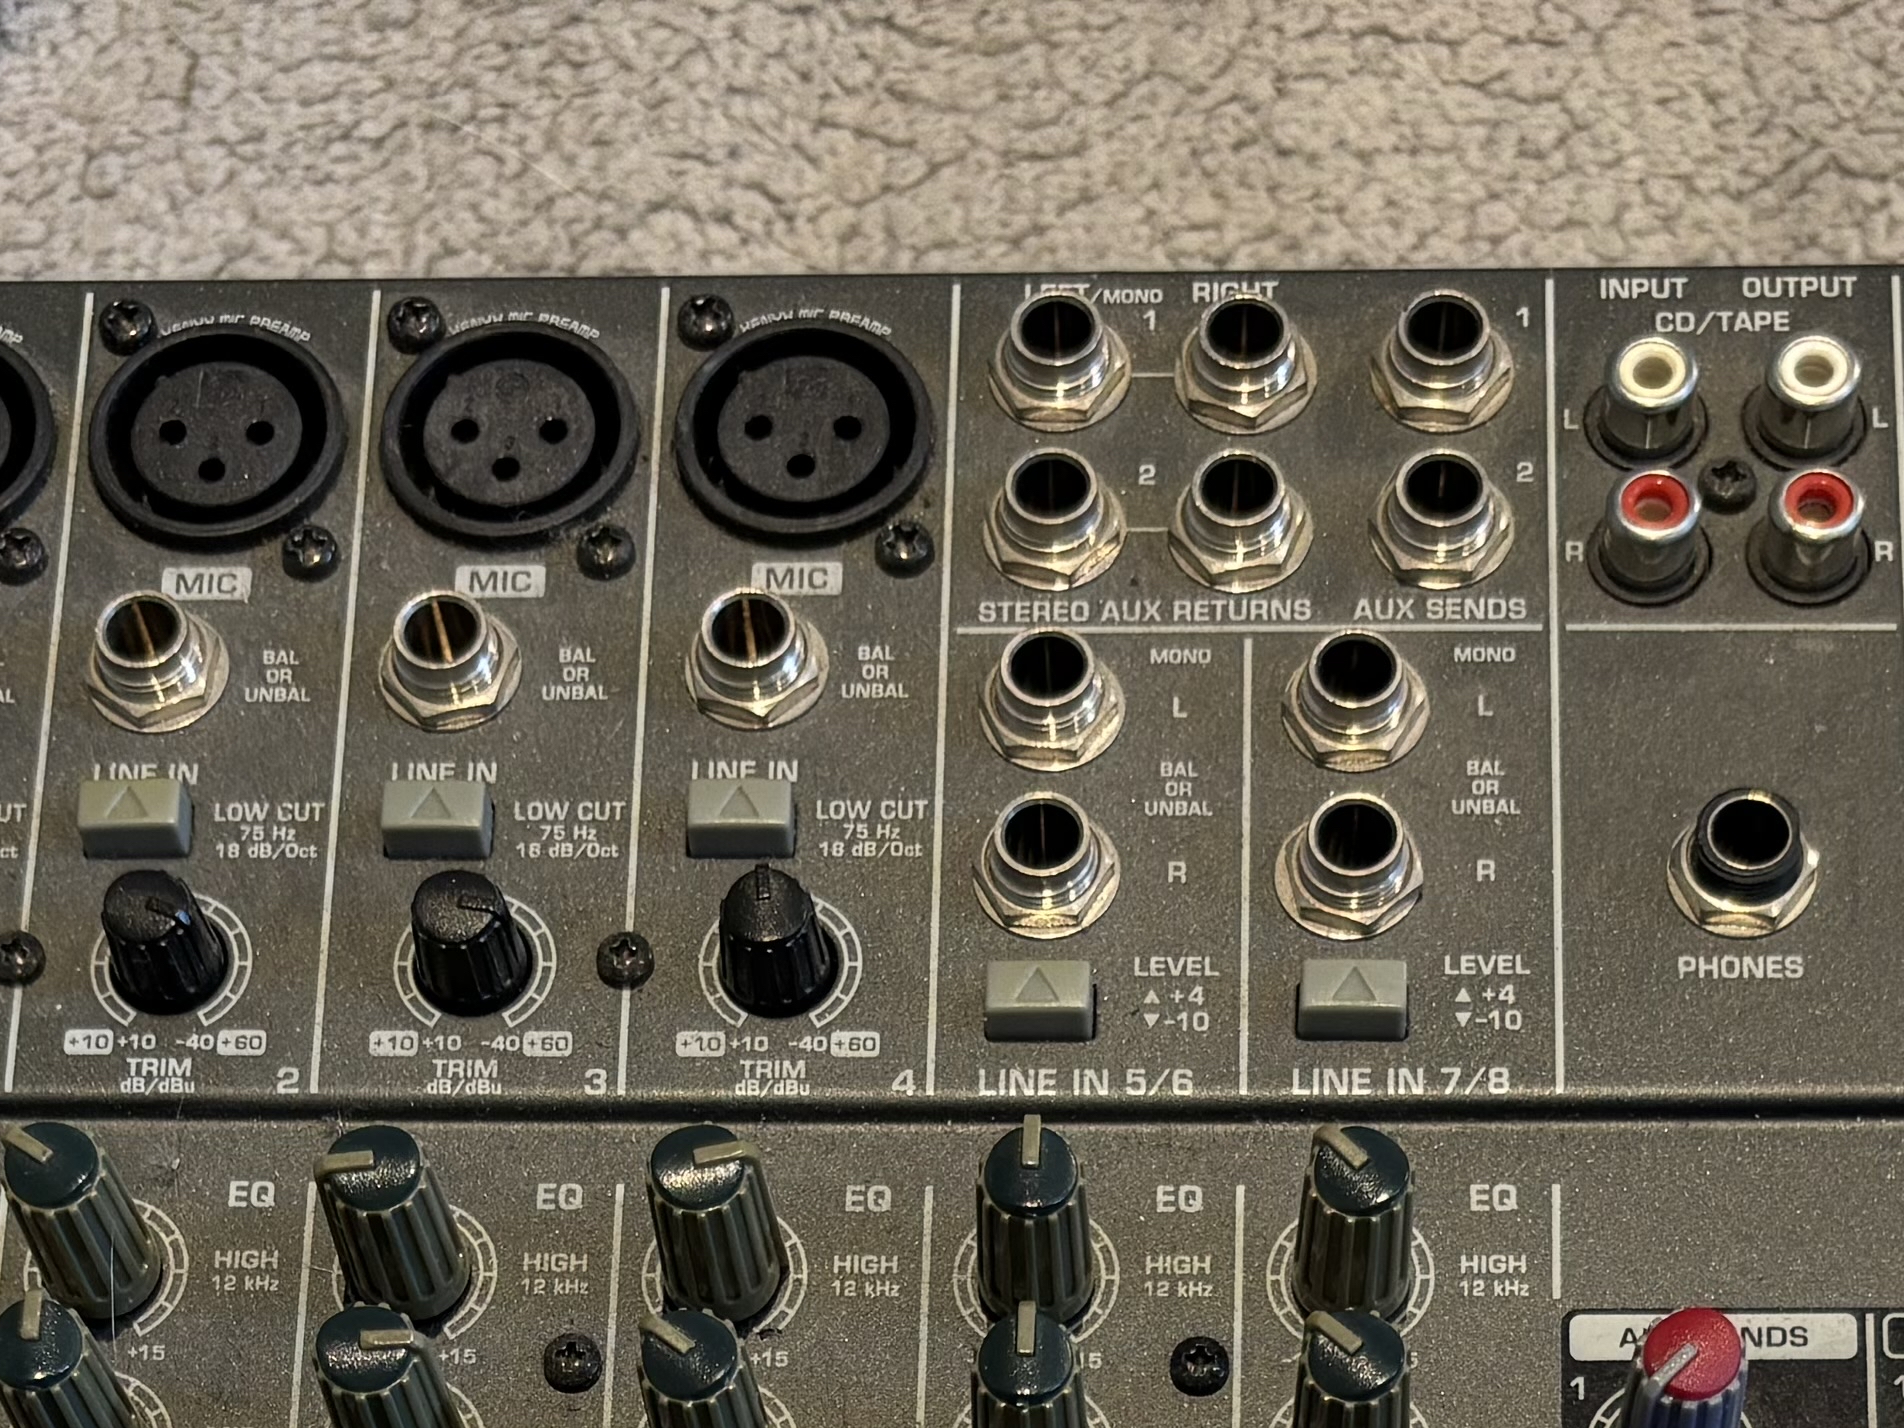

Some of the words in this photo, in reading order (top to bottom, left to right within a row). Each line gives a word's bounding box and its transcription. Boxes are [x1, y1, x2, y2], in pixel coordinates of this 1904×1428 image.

[1599, 279, 1688, 300] INPUT
[1742, 277, 1858, 298] OUTPUT
[1655, 310, 1791, 334] CD/TAPE
[175, 571, 238, 594] MIC
[468, 569, 532, 593] MIC
[765, 567, 829, 591] MIC
[978, 602, 1090, 622] STEREO
[1100, 601, 1162, 622] AUX
[1172, 601, 1311, 621] RETURNS
[1353, 599, 1415, 620] AUX
[1425, 599, 1527, 620] SENDS
[858, 645, 895, 662] BAL
[1150, 647, 1211, 664] MONO
[1453, 646, 1516, 663] MONO
[861, 664, 889, 681] OR
[841, 682, 908, 699] UNBAL
[1160, 761, 1199, 778] BAL
[1164, 781, 1192, 797] OR
[213, 803, 270, 822] LOW
[277, 802, 325, 821] CUT
[514, 801, 569, 820] LOW
[576, 801, 626, 820] CUT
[815, 800, 873, 820] LOW
[880, 800, 929, 819] CUT
[1144, 799, 1213, 816] UNBAL
[843, 824, 869, 841] 75
[876, 824, 901, 840] Hz
[1134, 957, 1219, 976] LEVEL
[1444, 955, 1530, 974] LEVEL
[1678, 955, 1804, 979] PHONES
[126, 1056, 192, 1076] TRIM
[432, 1058, 498, 1078] TRIM
[739, 1059, 806, 1079] TRIM
[277, 1067, 300, 1094] 2
[584, 1069, 608, 1095] 3
[734, 1078, 811, 1096] dB/dBu
[891, 1070, 915, 1095] 4
[977, 1068, 1057, 1096] LINE
[1071, 1068, 1109, 1096] IN
[1126, 1066, 1194, 1096] 5/6
[1292, 1067, 1372, 1096] LINE
[1387, 1068, 1424, 1095] IN
[1440, 1067, 1510, 1095] 7/8
[536, 1184, 584, 1211] EQ
[1469, 1184, 1517, 1211] EQ
[1144, 1255, 1211, 1275] HIGH
[1459, 1254, 1527, 1274] HIGH
[1144, 1281, 1169, 1297] 12
[1176, 1281, 1212, 1297] kHz
